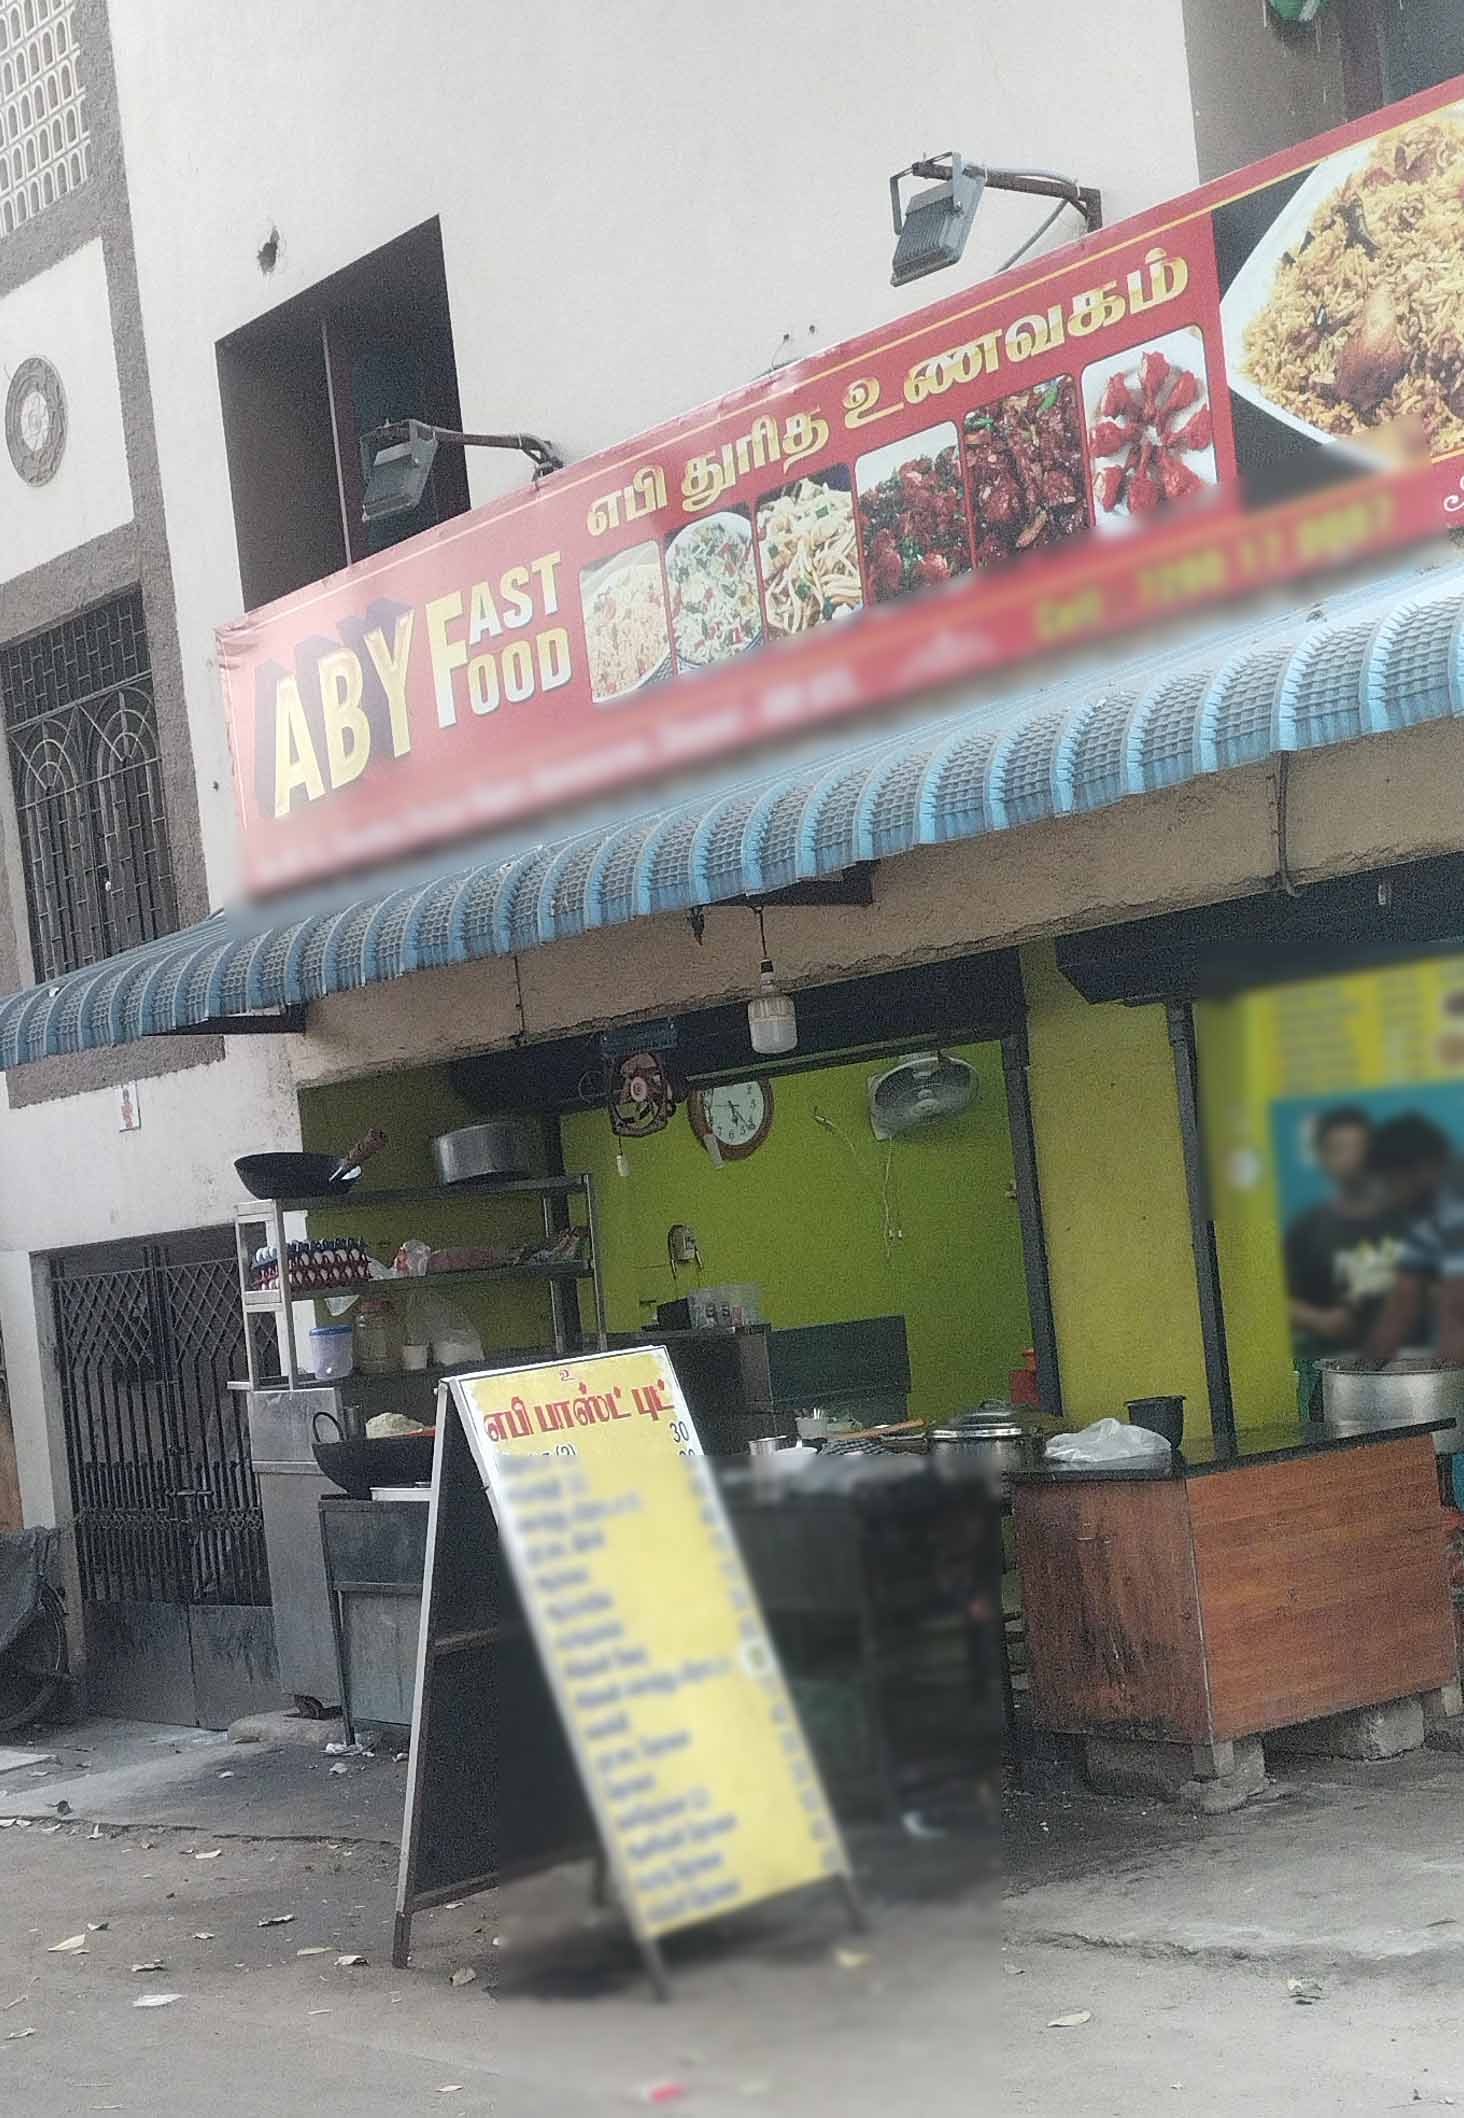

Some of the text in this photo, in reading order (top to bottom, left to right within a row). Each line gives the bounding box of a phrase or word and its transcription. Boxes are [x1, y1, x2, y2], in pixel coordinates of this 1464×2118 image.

[274, 552, 562, 819] ABY FAST
[669, 1420, 690, 1443] 30
